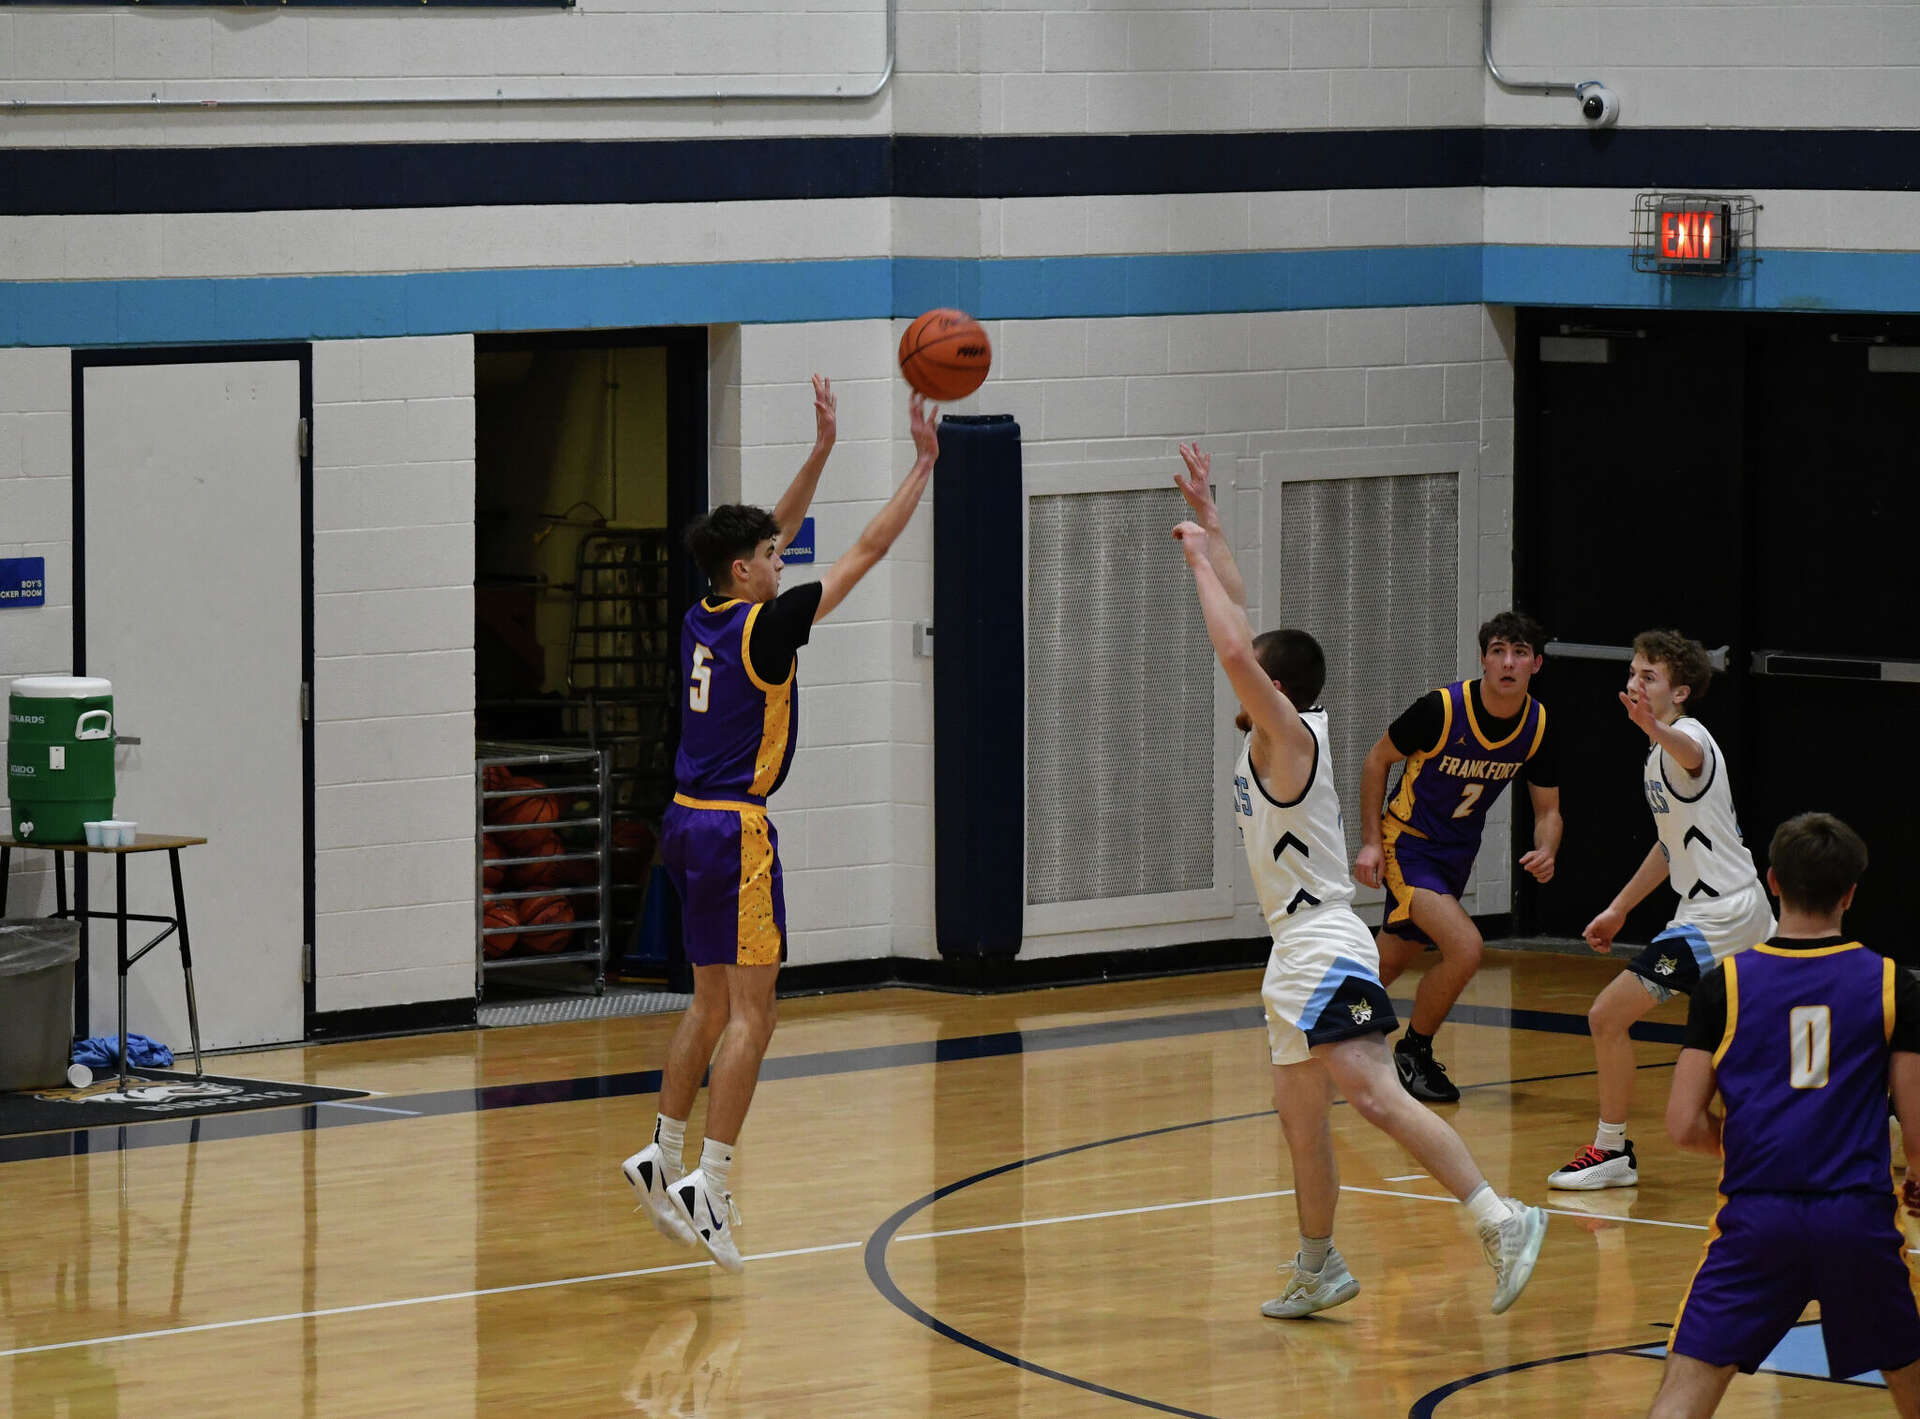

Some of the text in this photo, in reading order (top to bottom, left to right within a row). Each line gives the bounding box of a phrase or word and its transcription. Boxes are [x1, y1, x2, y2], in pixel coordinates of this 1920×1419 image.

[1661, 210, 1715, 258] EXIT
[783, 547, 813, 556] USTODIAL
[0, 589, 42, 598] CKER ROOM
[21, 580, 42, 588] BOY'S
[689, 641, 715, 713] 5
[1438, 755, 1523, 780] FRANKFORT
[1450, 783, 1485, 819] 2
[1789, 1004, 1832, 1089] 0
